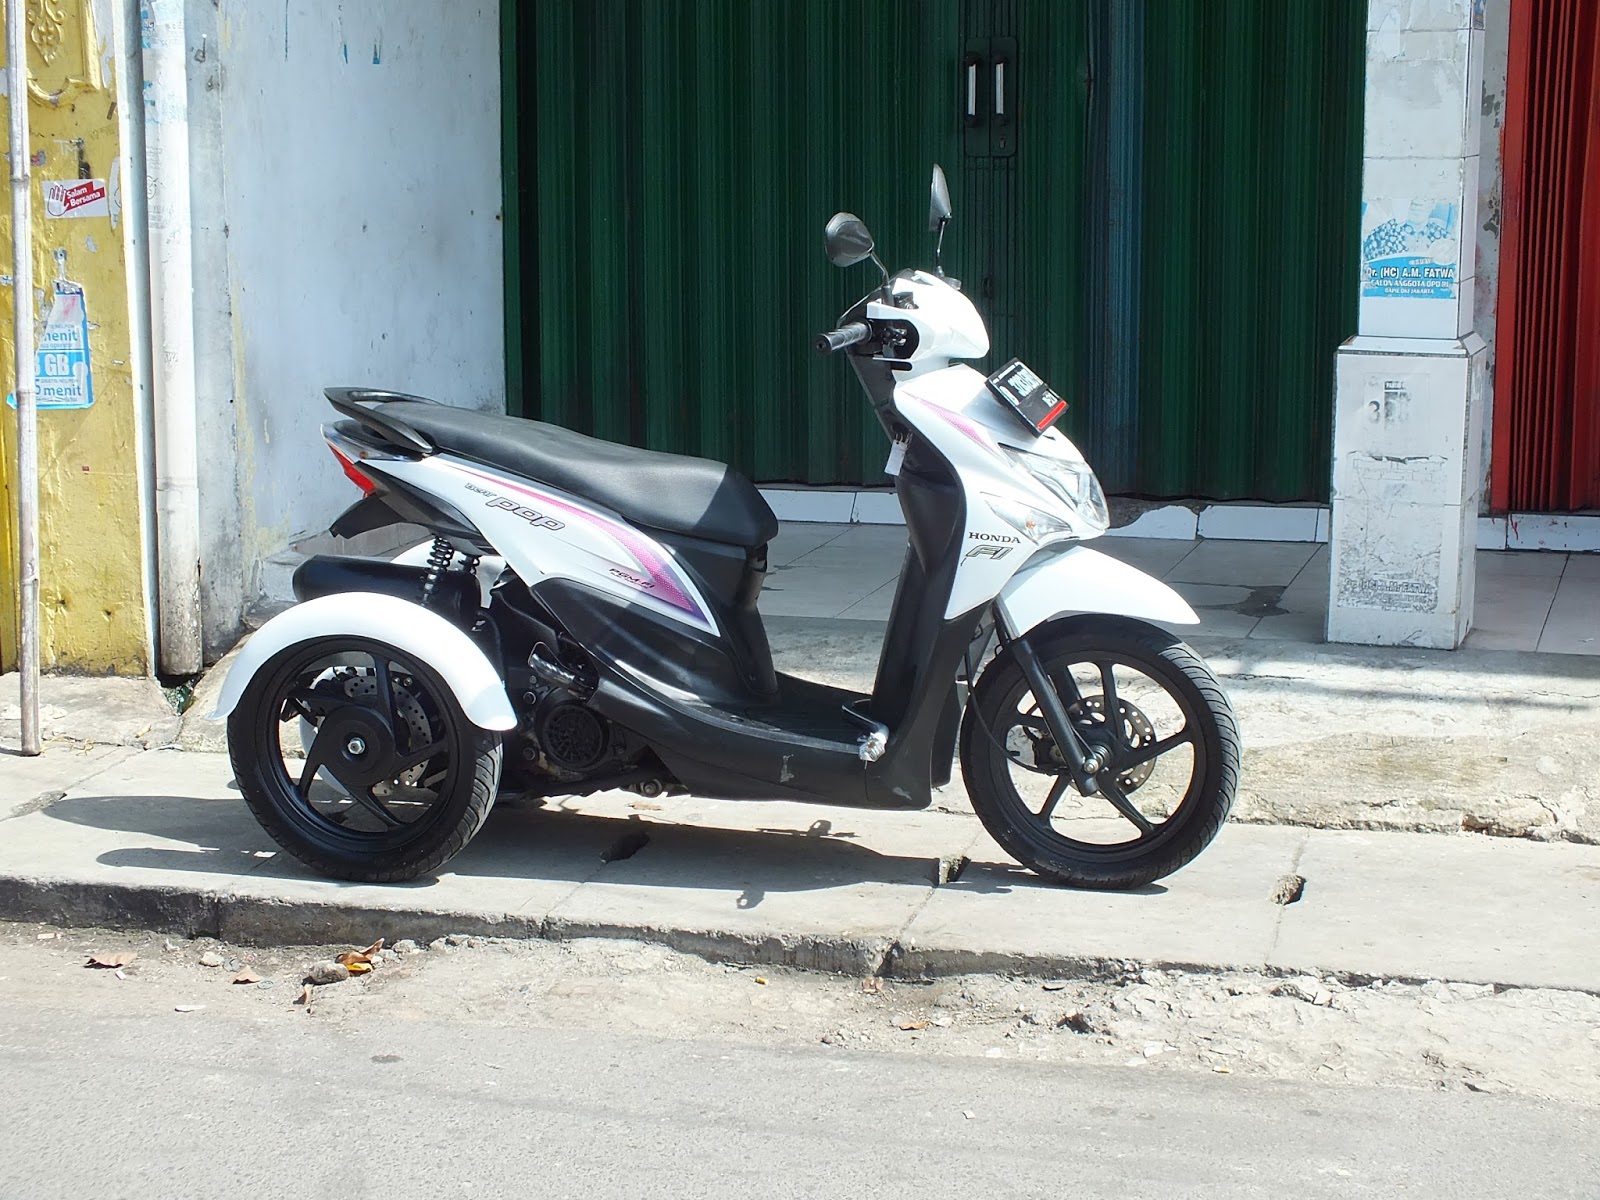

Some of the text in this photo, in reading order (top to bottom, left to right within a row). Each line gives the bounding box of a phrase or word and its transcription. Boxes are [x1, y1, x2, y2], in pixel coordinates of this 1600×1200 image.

[66, 187, 88, 199] Salam
[70, 191, 101, 207] Bersama
[1380, 267, 1400, 279] (HC)
[1402, 267, 1422, 278] A.M.
[1424, 267, 1455, 279] FATWA
[1394, 280, 1426, 288] ANGGOTA
[44, 353, 70, 376] GB
[43, 384, 82, 396] menit
[968, 531, 1022, 544] HONDA
